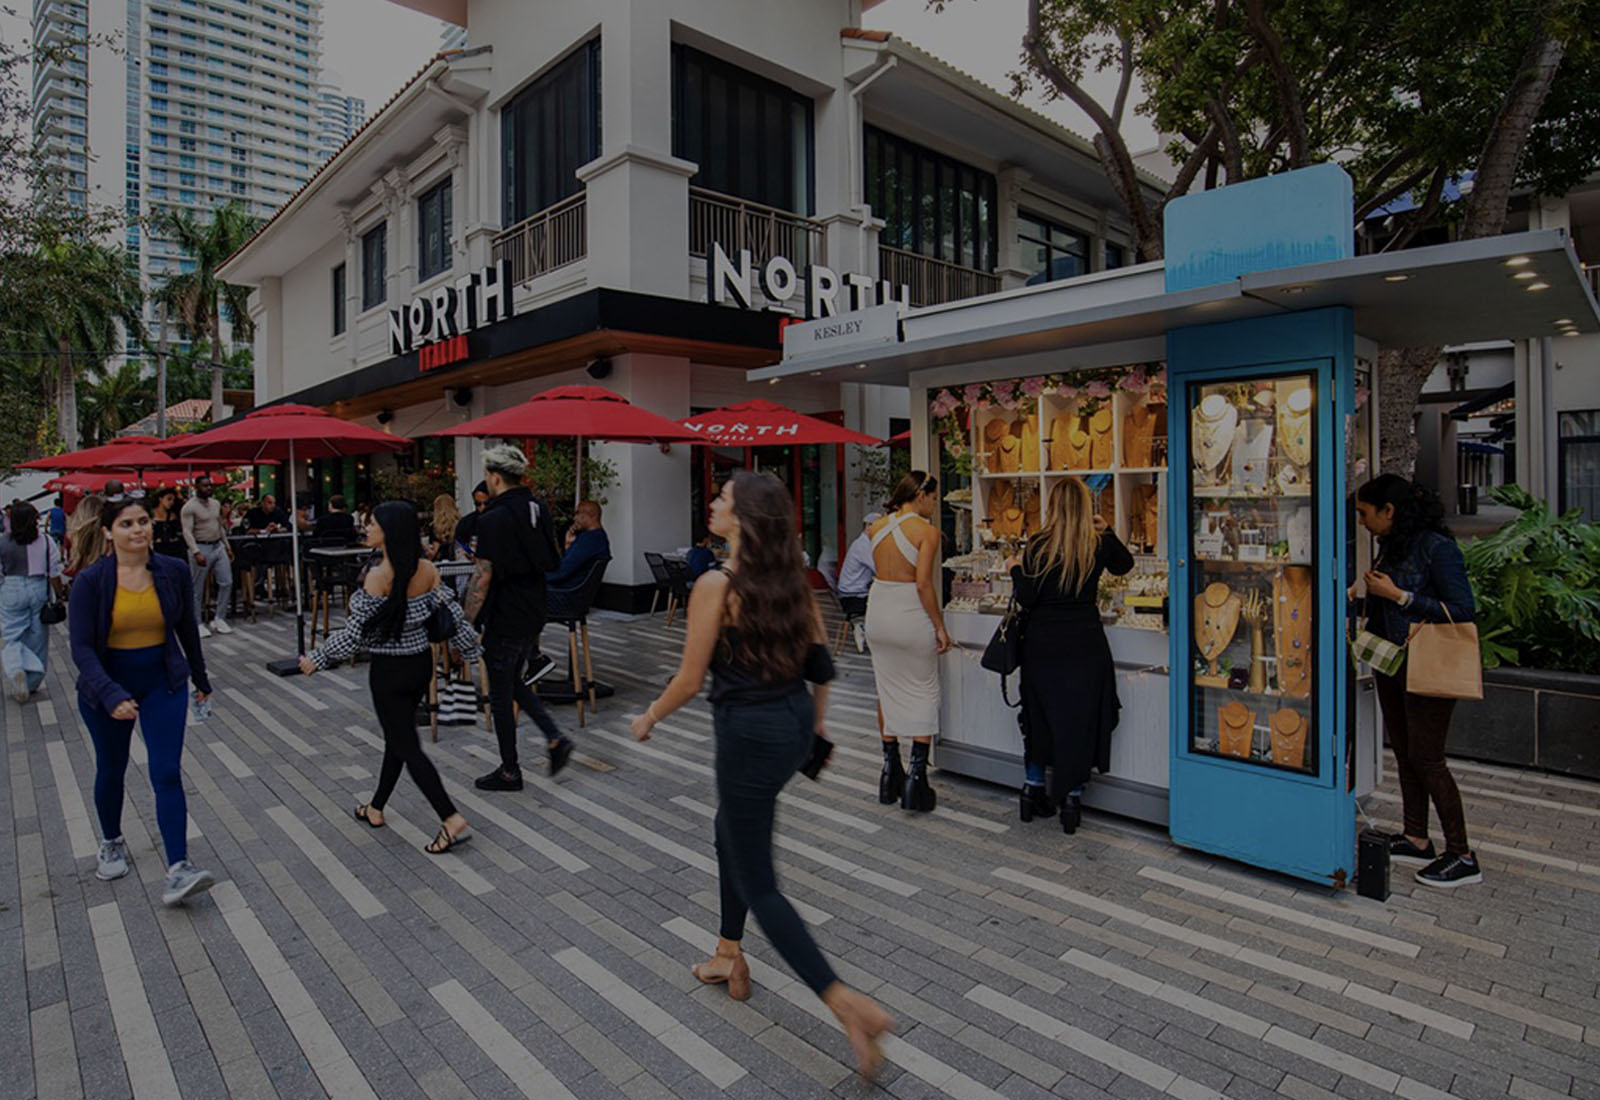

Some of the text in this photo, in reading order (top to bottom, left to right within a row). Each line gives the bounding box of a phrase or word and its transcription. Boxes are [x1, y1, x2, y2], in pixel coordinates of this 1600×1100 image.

[388, 258, 512, 354] NORTH
[814, 320, 863, 341] KESLEY
[418, 335, 469, 372] ITALIA
